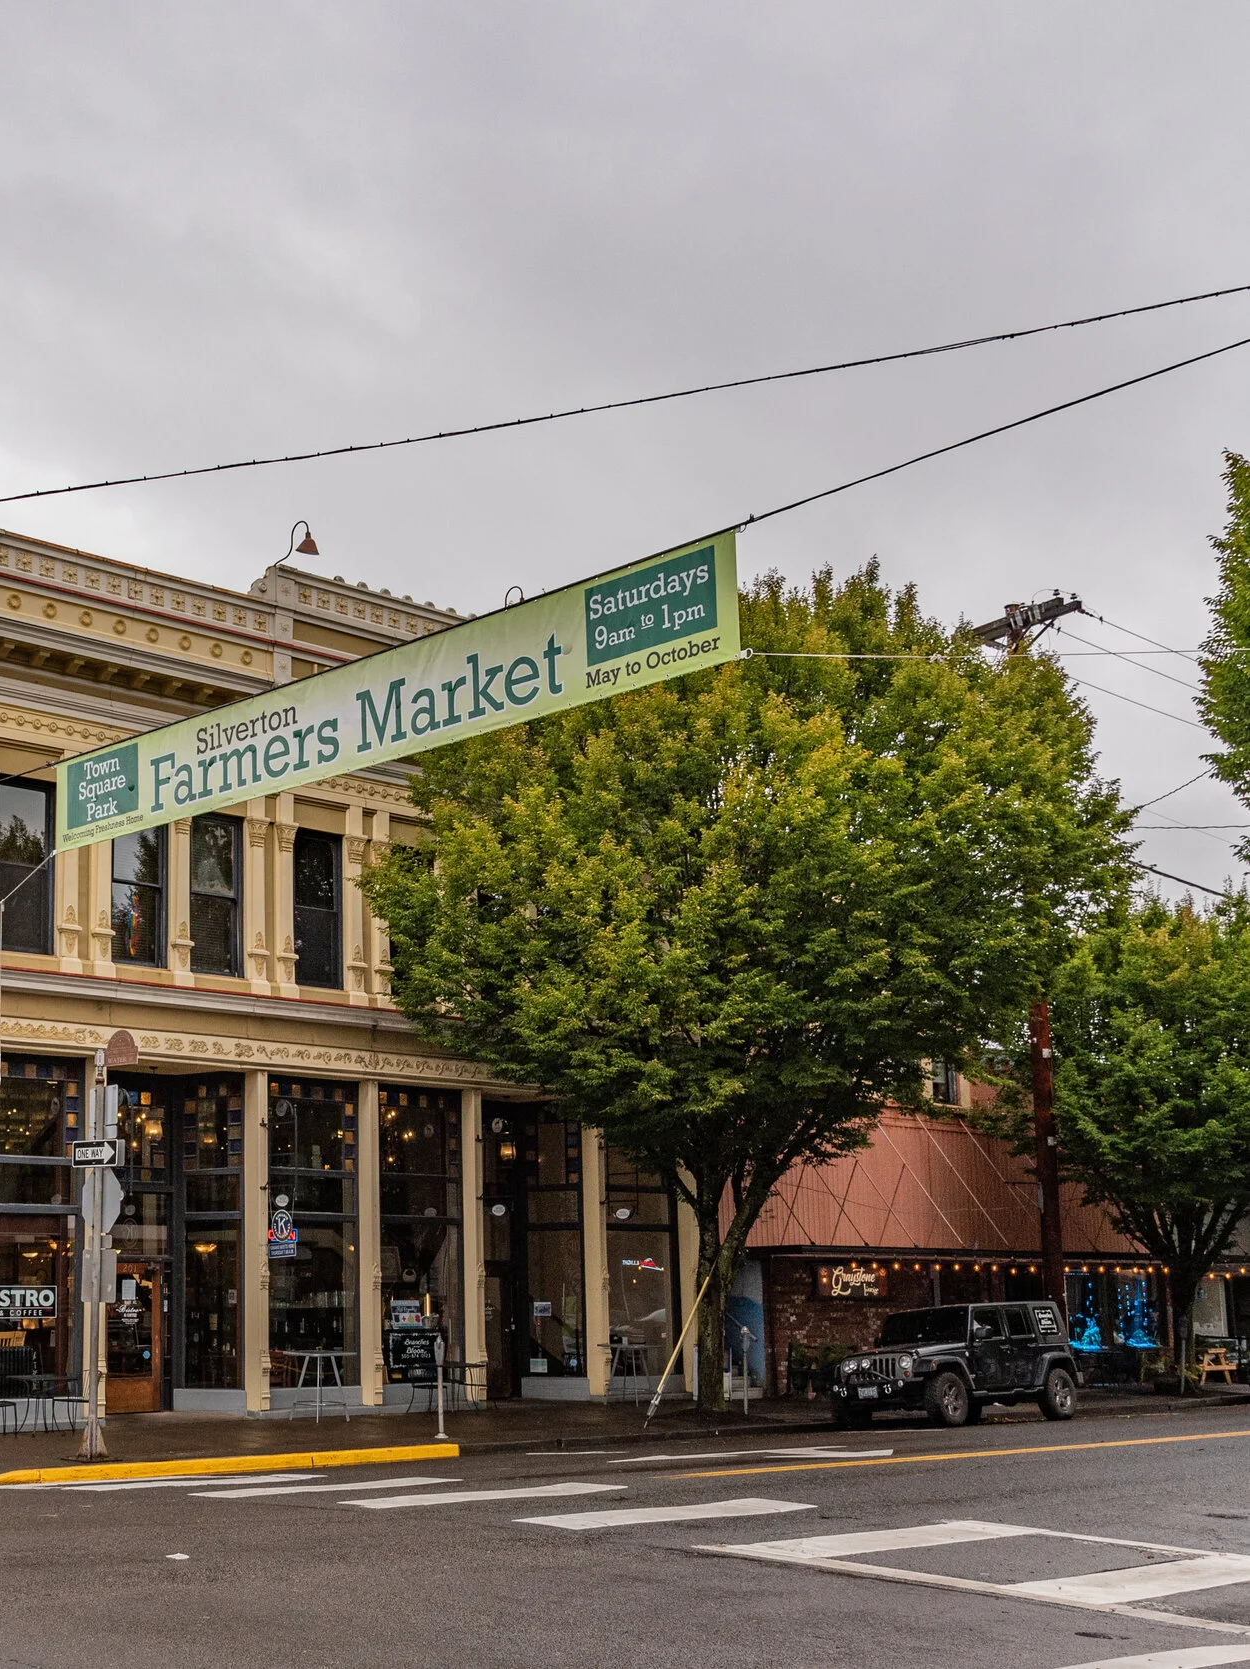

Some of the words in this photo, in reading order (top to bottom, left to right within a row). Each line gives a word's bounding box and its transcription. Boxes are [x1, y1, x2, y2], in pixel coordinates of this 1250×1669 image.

[589, 564, 709, 620] Saturdays
[594, 625, 636, 650] 9am
[640, 613, 655, 628] to
[661, 603, 706, 631] 1pm
[585, 666, 621, 689] May
[625, 661, 641, 677] to
[646, 637, 721, 669] October
[150, 715, 341, 813] Farmers
[356, 633, 565, 754] Market
[196, 706, 299, 755] Silverton
[83, 757, 120, 780] Town
[78, 774, 127, 802] Square
[62, 828, 95, 843] Welcoming
[95, 820, 126, 835] Freshness
[125, 814, 144, 826] Home
[86, 797, 119, 822] Park
[77, 1149, 90, 1159] ONE
[91, 1148, 104, 1158] WAY
